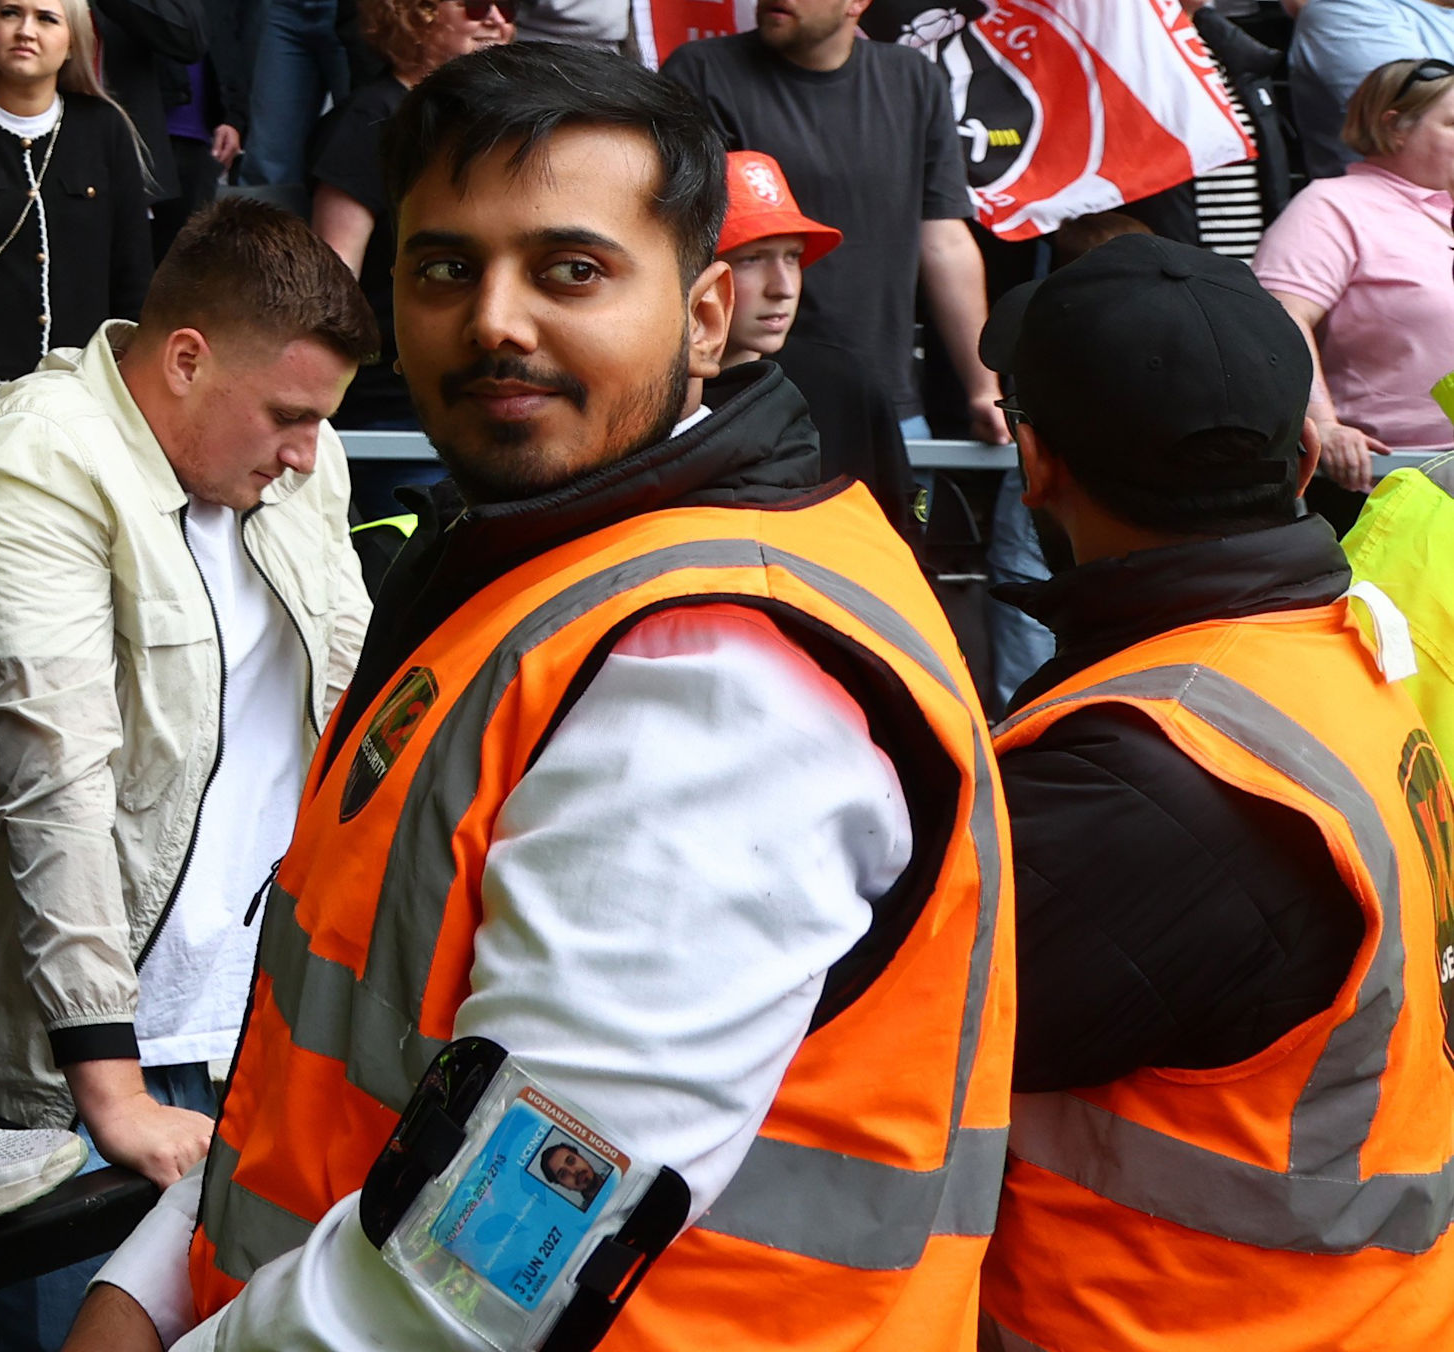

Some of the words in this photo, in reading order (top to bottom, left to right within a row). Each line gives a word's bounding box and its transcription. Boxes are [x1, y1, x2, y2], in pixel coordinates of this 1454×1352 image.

[526, 1090, 589, 1138] SUPERVISOR
[515, 1125, 548, 1167] LICENCE
[587, 1133, 620, 1159] DOOR
[536, 1225, 565, 1259] 2027
[519, 1255, 546, 1287] JUN
[513, 1282, 528, 1297] 3
